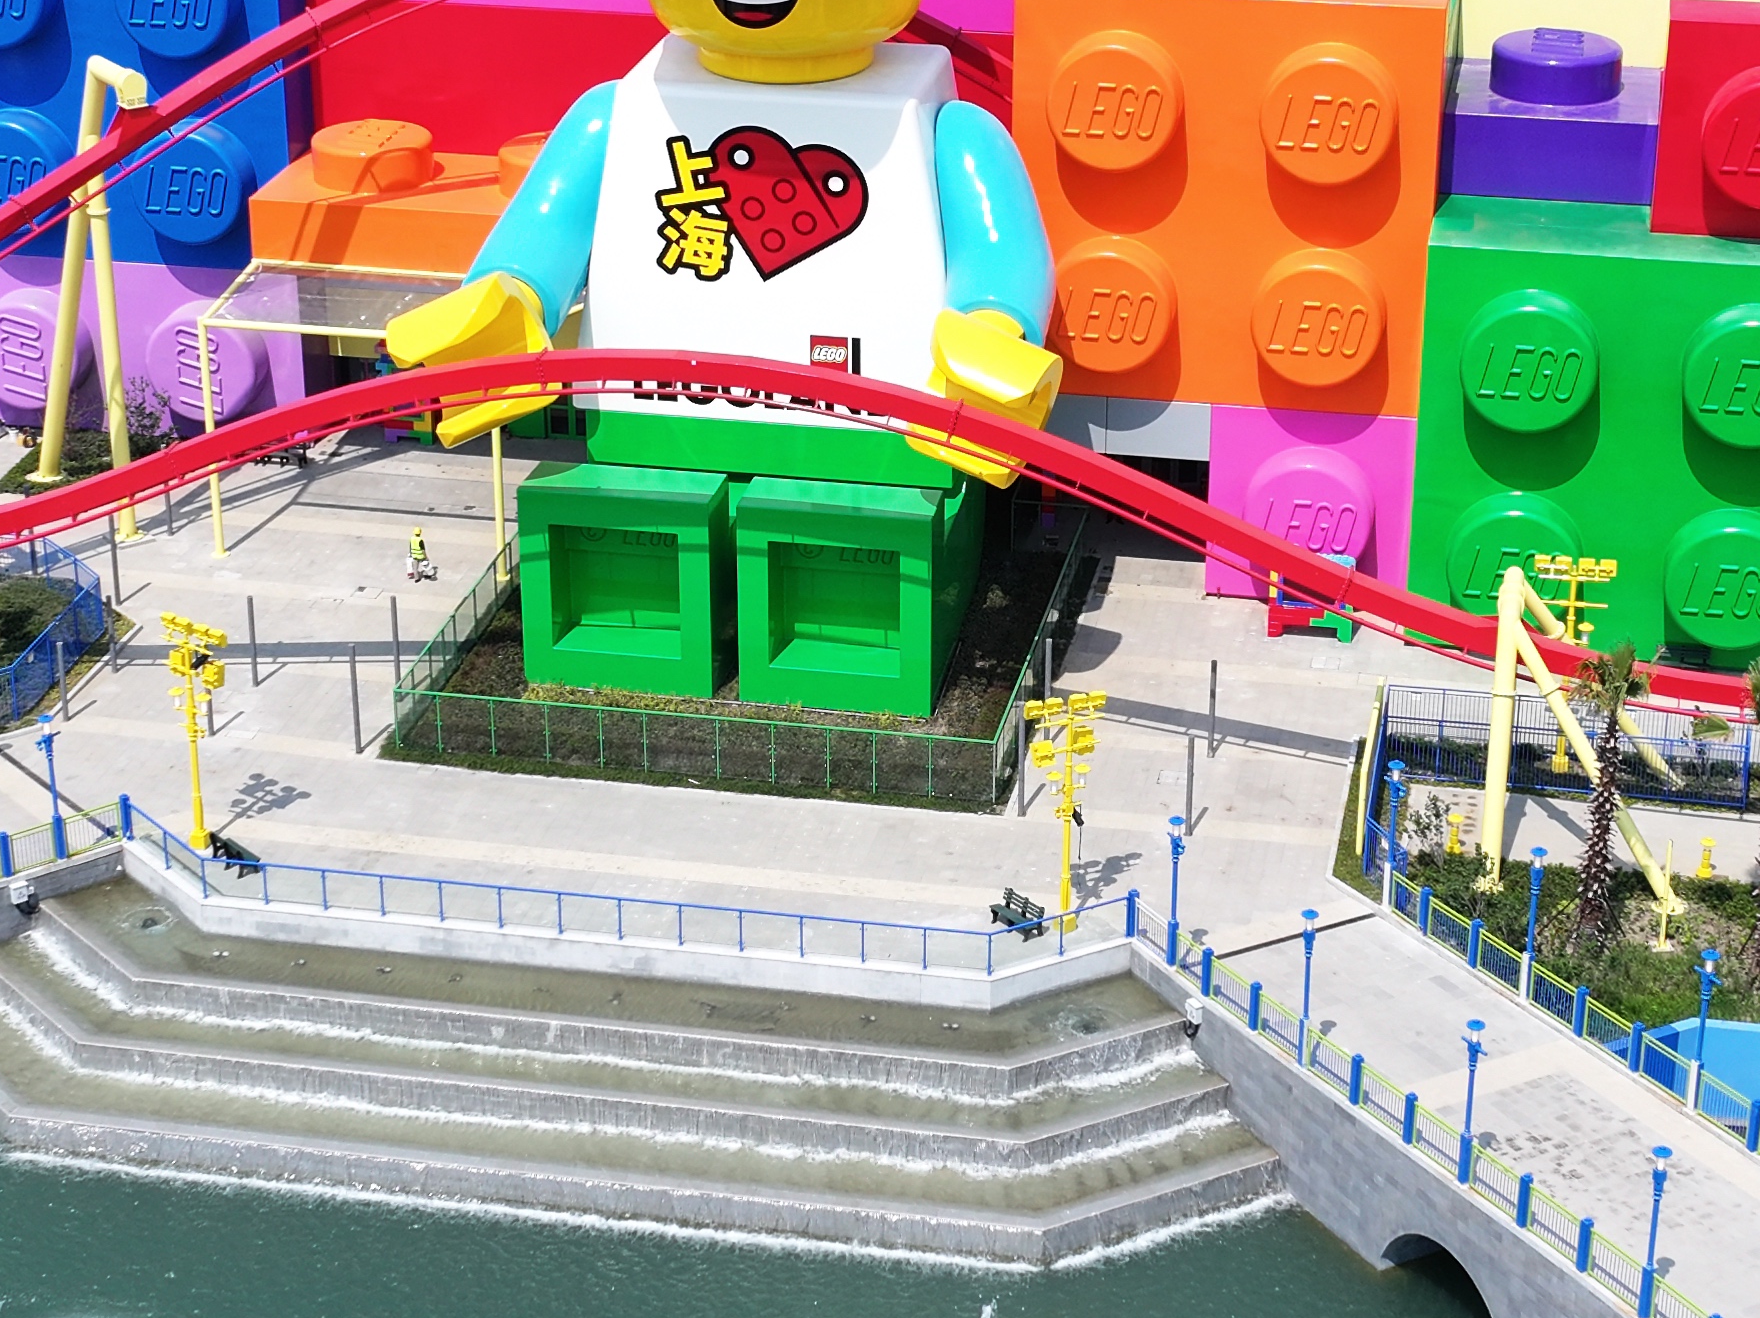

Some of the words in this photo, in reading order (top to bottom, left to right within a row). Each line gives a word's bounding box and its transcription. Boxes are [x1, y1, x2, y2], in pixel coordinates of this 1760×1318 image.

[1062, 81, 1163, 140] LEGO
[1275, 94, 1380, 153] LEGO
[144, 164, 228, 217] LEGO
[658, 138, 731, 278] 上海
[1057, 286, 1157, 343] LEGO
[1266, 299, 1369, 357] LEGO
[811, 344, 847, 364] LEGO
[1475, 343, 1584, 401] LEGO
[1262, 497, 1358, 554] LEGO
